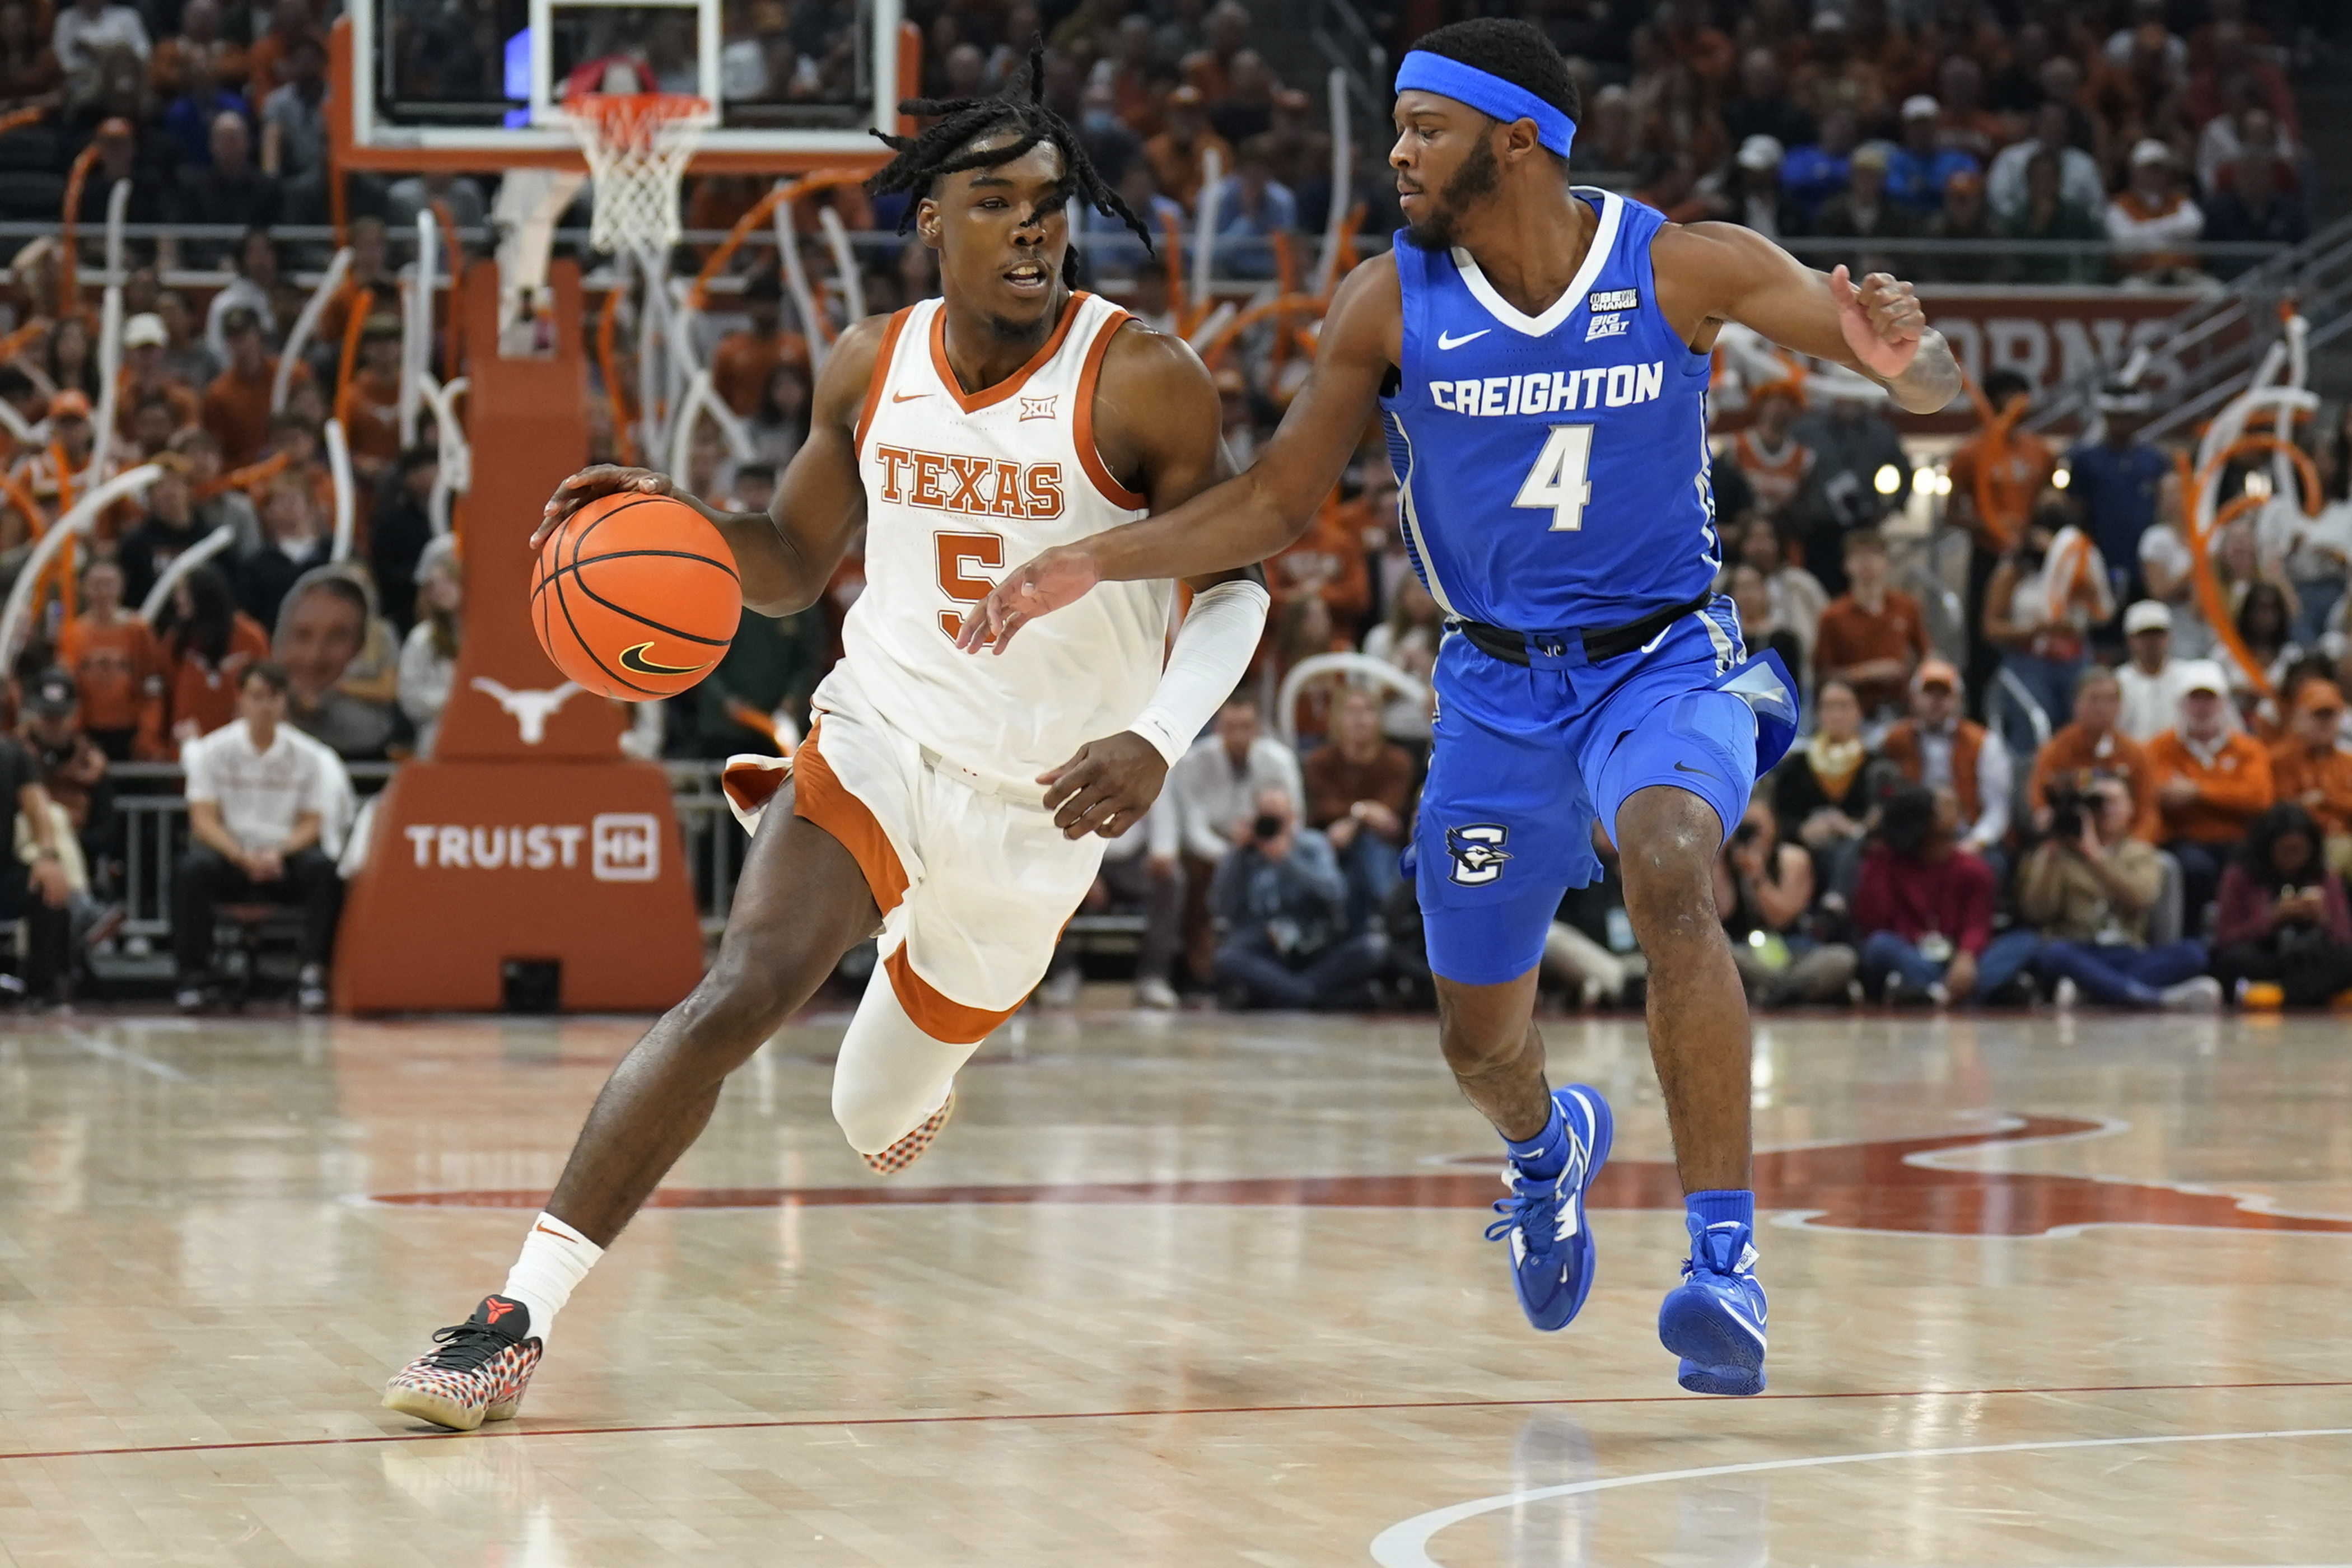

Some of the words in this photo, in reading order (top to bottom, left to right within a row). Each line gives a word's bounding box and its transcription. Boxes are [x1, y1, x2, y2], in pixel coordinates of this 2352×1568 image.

[1586, 320, 1630, 337] EAST
[1590, 312, 1621, 325] BIG
[1429, 361, 1663, 417] CREIGHTON
[875, 442, 1065, 520] TEXAS
[1511, 423, 1595, 531] 4
[934, 530, 1005, 647] 5
[404, 824, 586, 870] TRUIST
